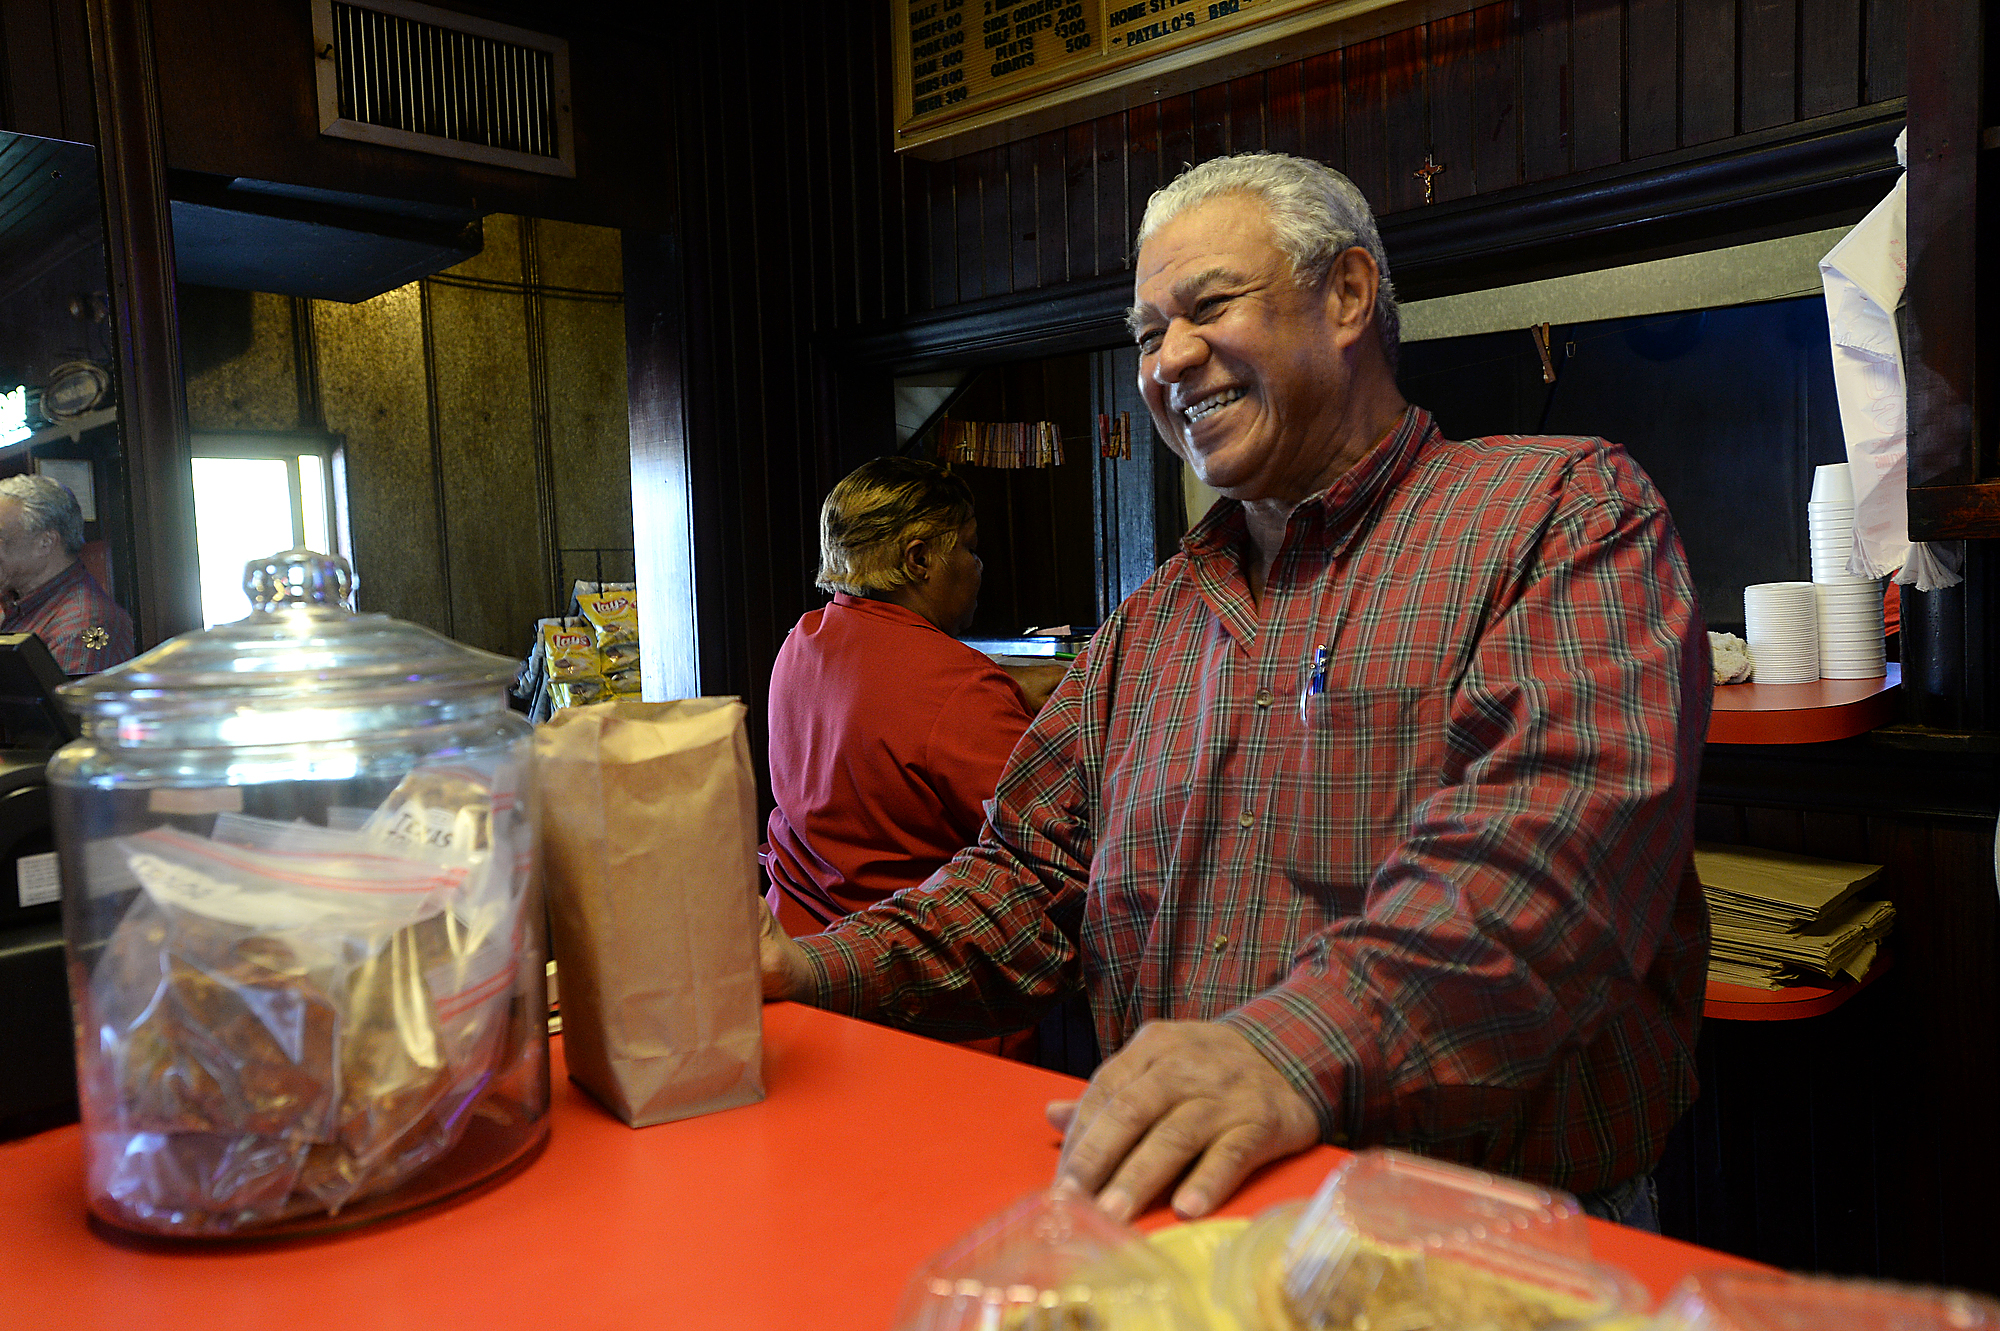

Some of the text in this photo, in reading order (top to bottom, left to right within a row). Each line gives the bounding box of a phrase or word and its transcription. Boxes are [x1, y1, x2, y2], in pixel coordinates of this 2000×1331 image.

[983, 13, 1008, 34] SIDE
[1013, 0, 1062, 22] ORDERS
[984, 4, 1082, 49] HALF PINTS 200
[1110, 2, 1146, 27] HOME
[1127, 0, 1240, 47] PATILLO'S BBQ
[912, 22, 938, 42] BEEF
[996, 18, 1086, 60] PINTS $300
[913, 39, 942, 60] PORK
[991, 33, 1091, 77] QUARTS 500
[915, 59, 937, 78] HAM
[945, 86, 968, 104] 300
